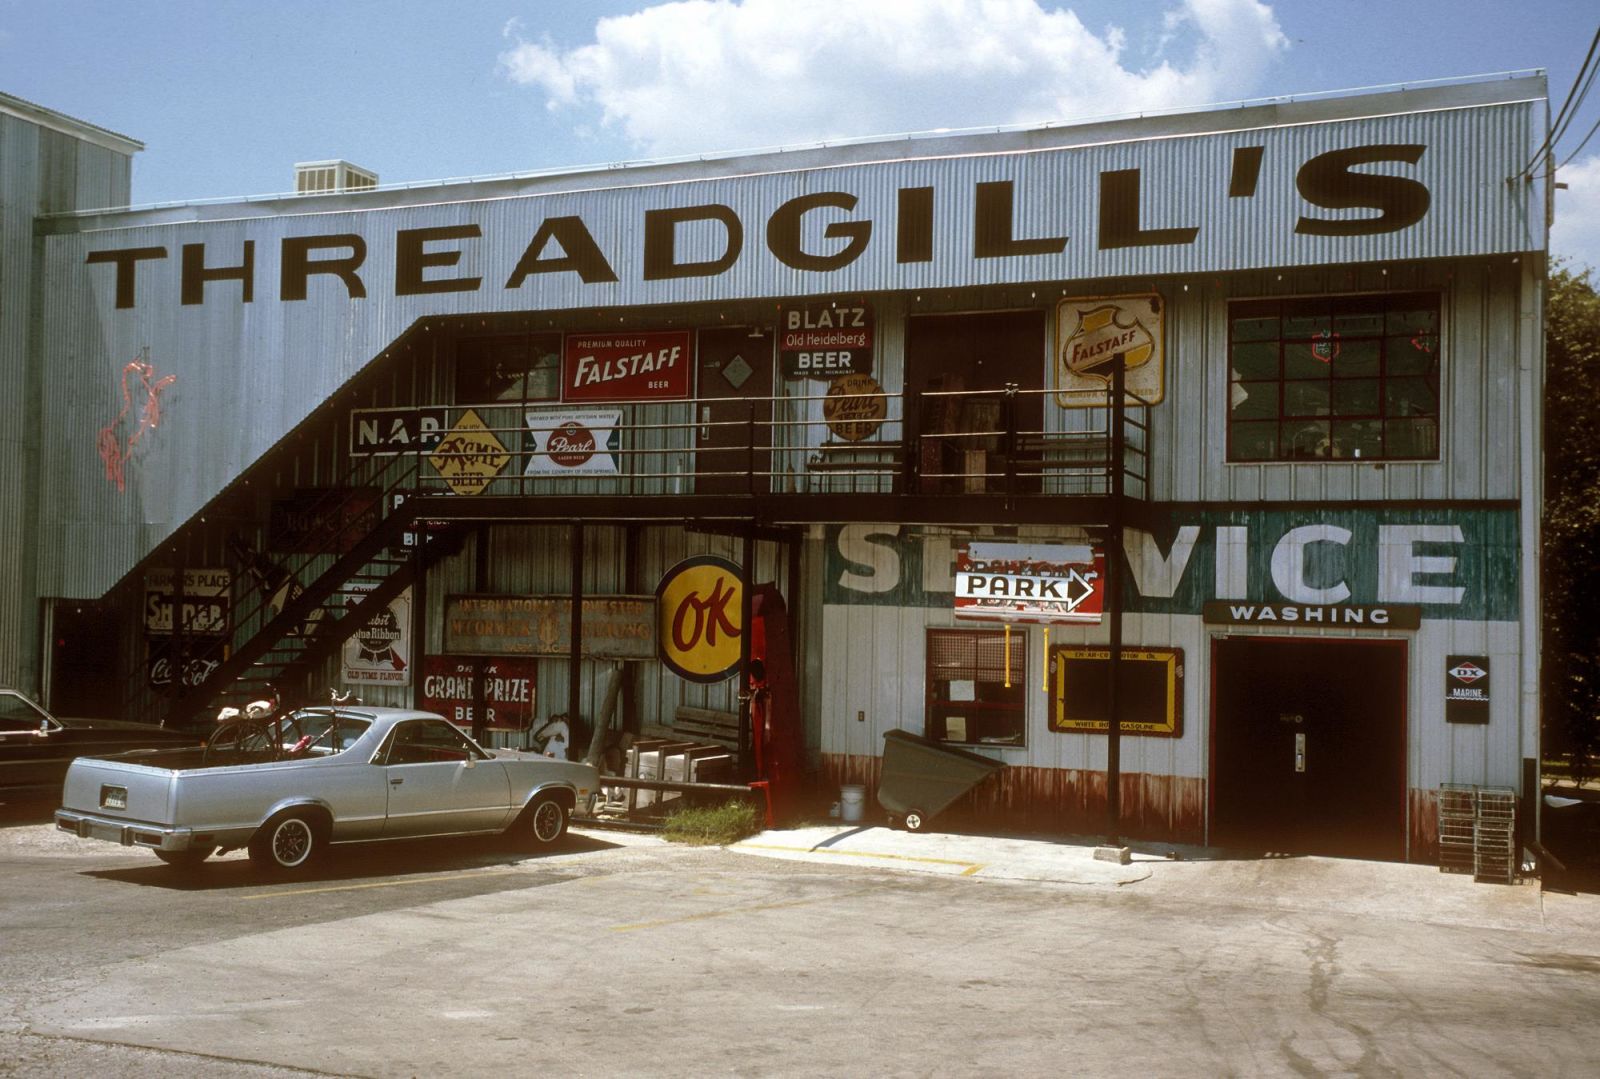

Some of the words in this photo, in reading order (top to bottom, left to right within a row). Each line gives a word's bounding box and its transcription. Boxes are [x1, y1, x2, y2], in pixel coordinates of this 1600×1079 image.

[86, 144, 1431, 310] THREADGILL'S
[788, 308, 865, 330] BLATZ
[577, 340, 612, 349] PREMIUM
[614, 339, 647, 348] QUALITY
[786, 333, 804, 347] Old
[806, 331, 867, 347] Heidelberg
[1072, 330, 1136, 364] FALSTAFF
[574, 346, 681, 387] FALSTAFF
[798, 351, 852, 369] BEER
[648, 380, 669, 389] BEER
[835, 422, 874, 434] BEER
[550, 436, 593, 453] Pearl
[452, 472, 484, 487] BEER
[837, 524, 1466, 605] SVICE
[198, 575, 229, 588] PLACE
[967, 575, 1063, 599] PARK
[147, 594, 223, 623] SHNER
[672, 577, 741, 652] OK
[1230, 605, 1389, 624] WASHING
[371, 627, 400, 640] Ribbon
[347, 671, 361, 680] OLD
[361, 672, 378, 680] TIME
[380, 672, 404, 681] FLAVOR
[484, 678, 530, 702] PRIZE
[1453, 688, 1482, 697] MARINE
[455, 706, 496, 722] BER
